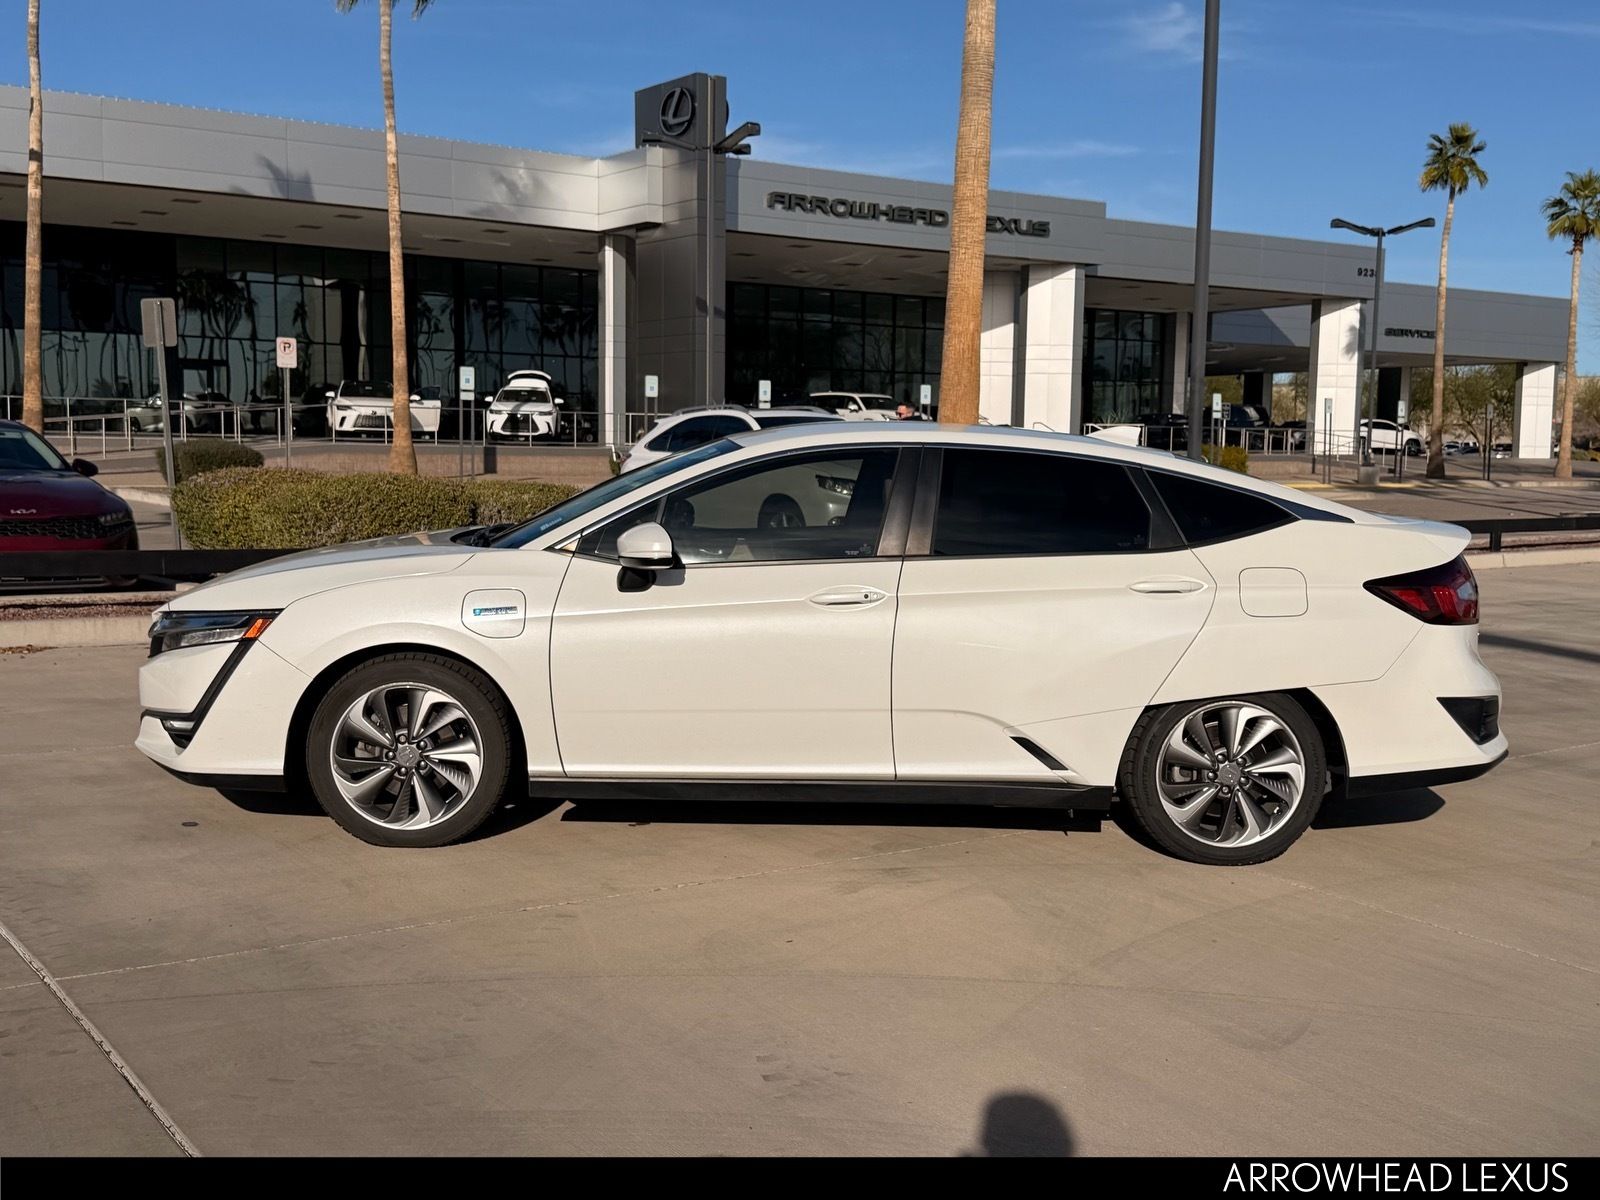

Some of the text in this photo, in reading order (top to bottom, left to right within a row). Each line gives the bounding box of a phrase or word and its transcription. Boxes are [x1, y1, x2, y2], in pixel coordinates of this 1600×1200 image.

[767, 191, 1051, 238] ARROWHEAD EXUS
[1357, 267, 1377, 278] 923
[1384, 327, 1436, 339] SERVICE
